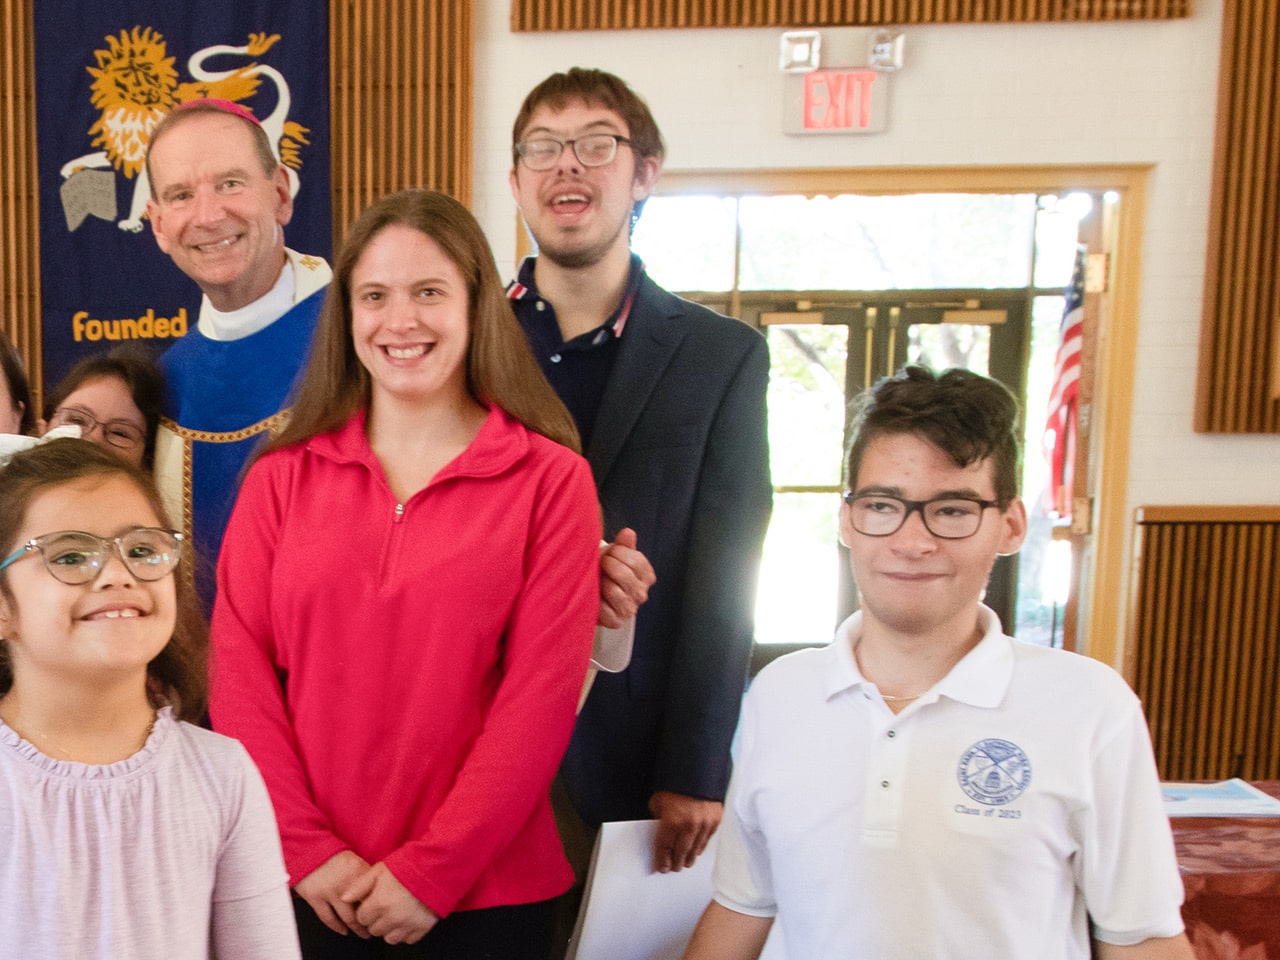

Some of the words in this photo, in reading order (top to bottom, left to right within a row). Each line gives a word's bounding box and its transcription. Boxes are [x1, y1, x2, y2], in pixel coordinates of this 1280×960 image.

[803, 72, 878, 129] EXIT
[954, 805, 980, 815] Class
[983, 807, 995, 817] of
